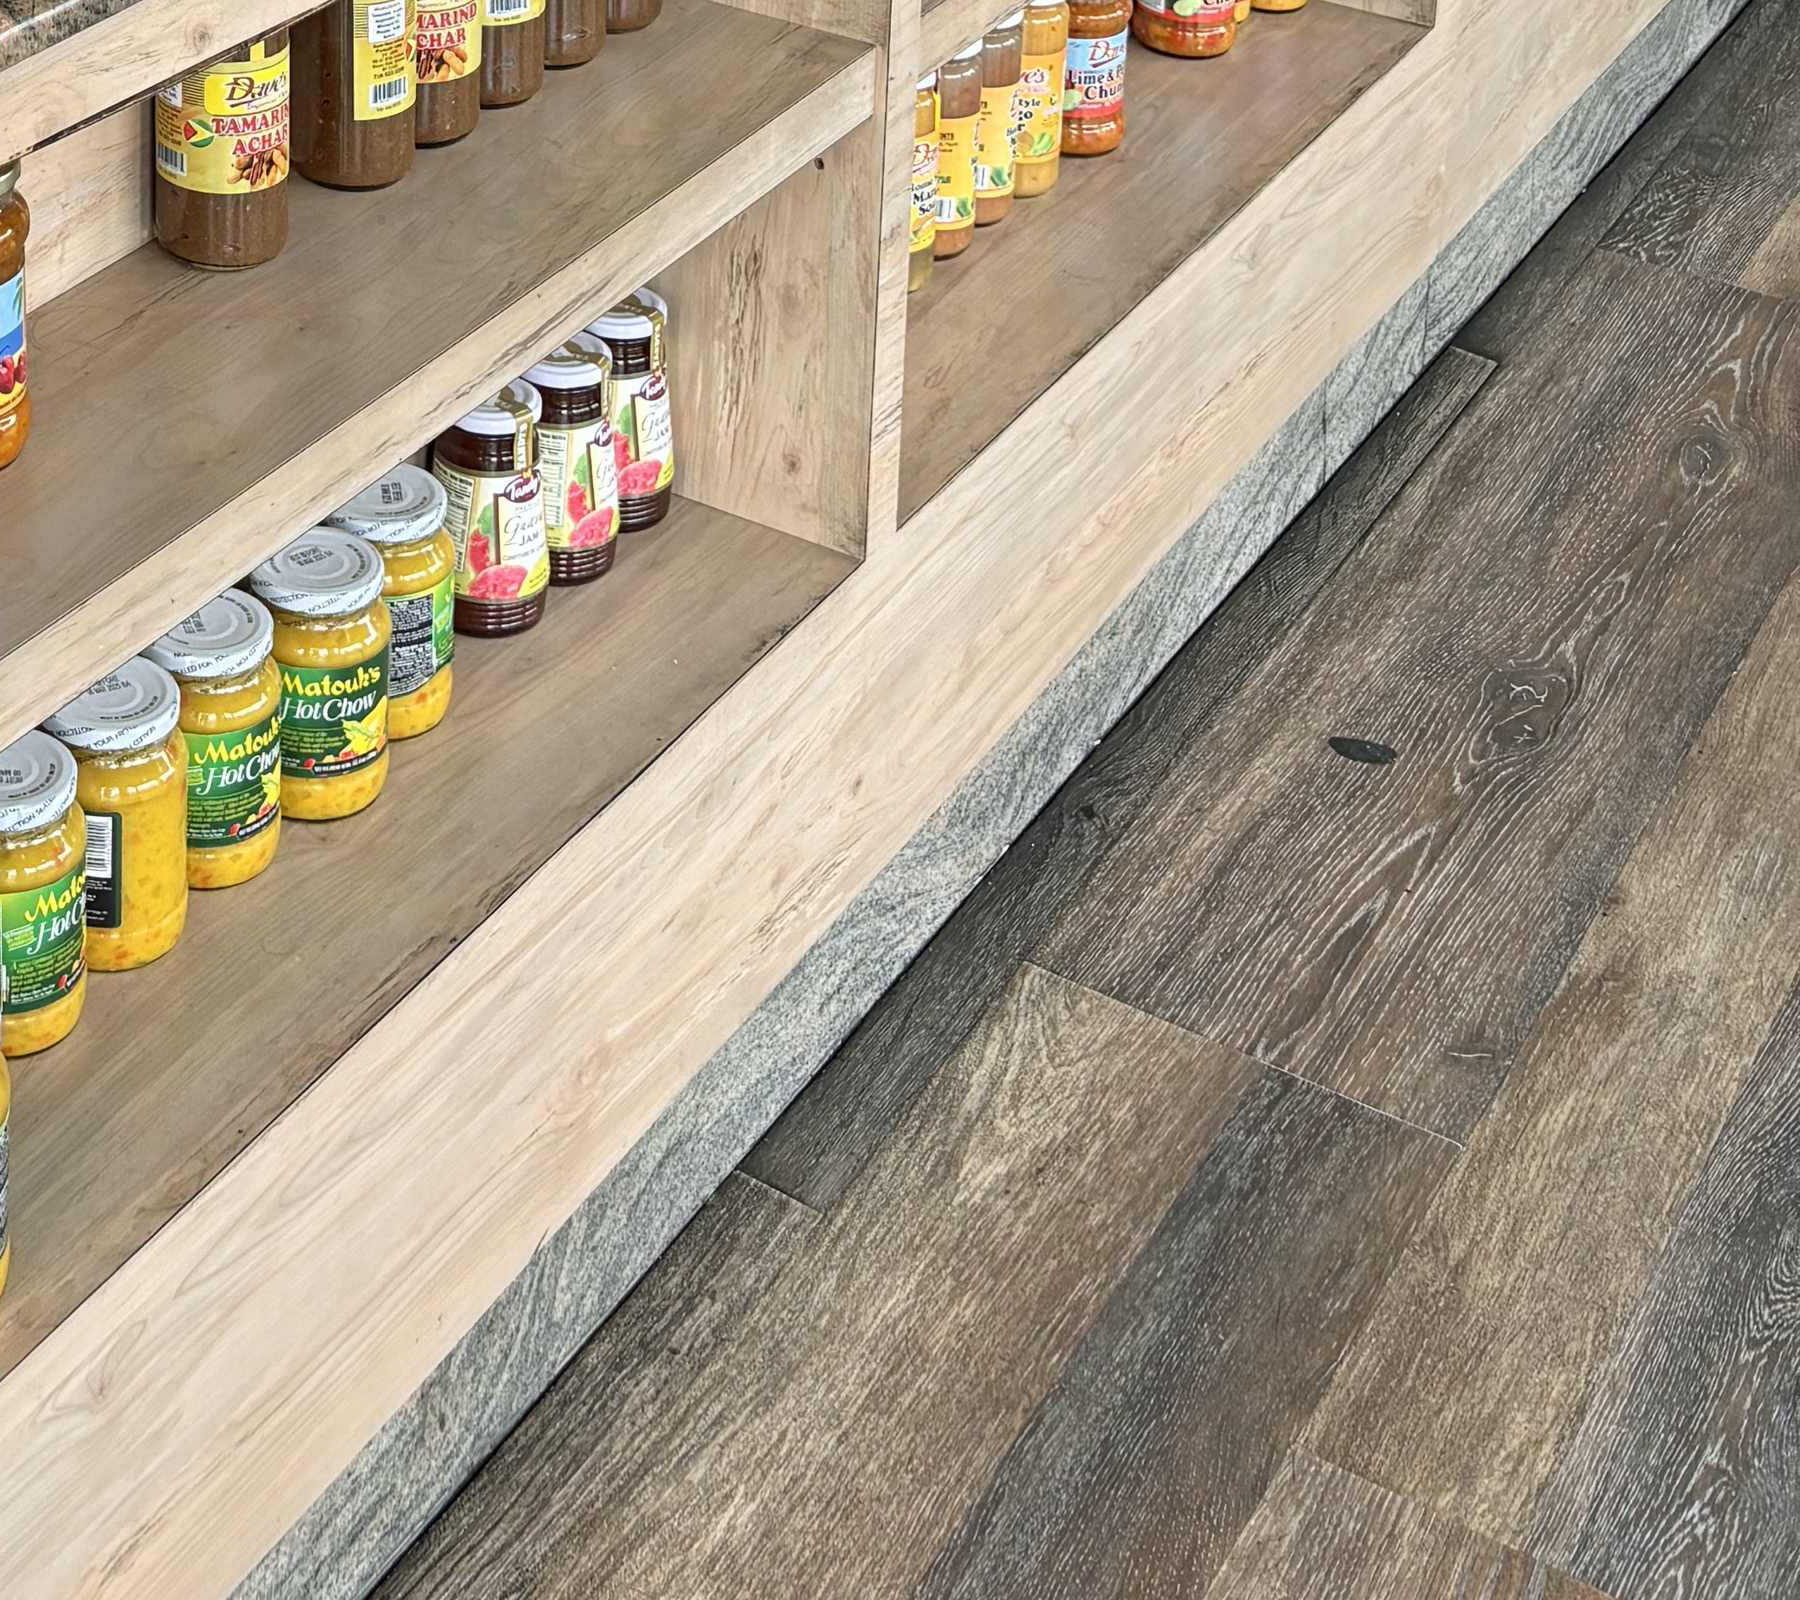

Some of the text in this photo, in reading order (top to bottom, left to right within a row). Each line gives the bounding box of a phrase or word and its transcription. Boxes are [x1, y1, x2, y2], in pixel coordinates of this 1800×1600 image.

[1066, 70, 1105, 86] Lime
[282, 665, 381, 697] Matouk's
[279, 690, 377, 721] Hot Chow
[196, 764, 245, 795] Hot
[27, 911, 71, 955] Hot
